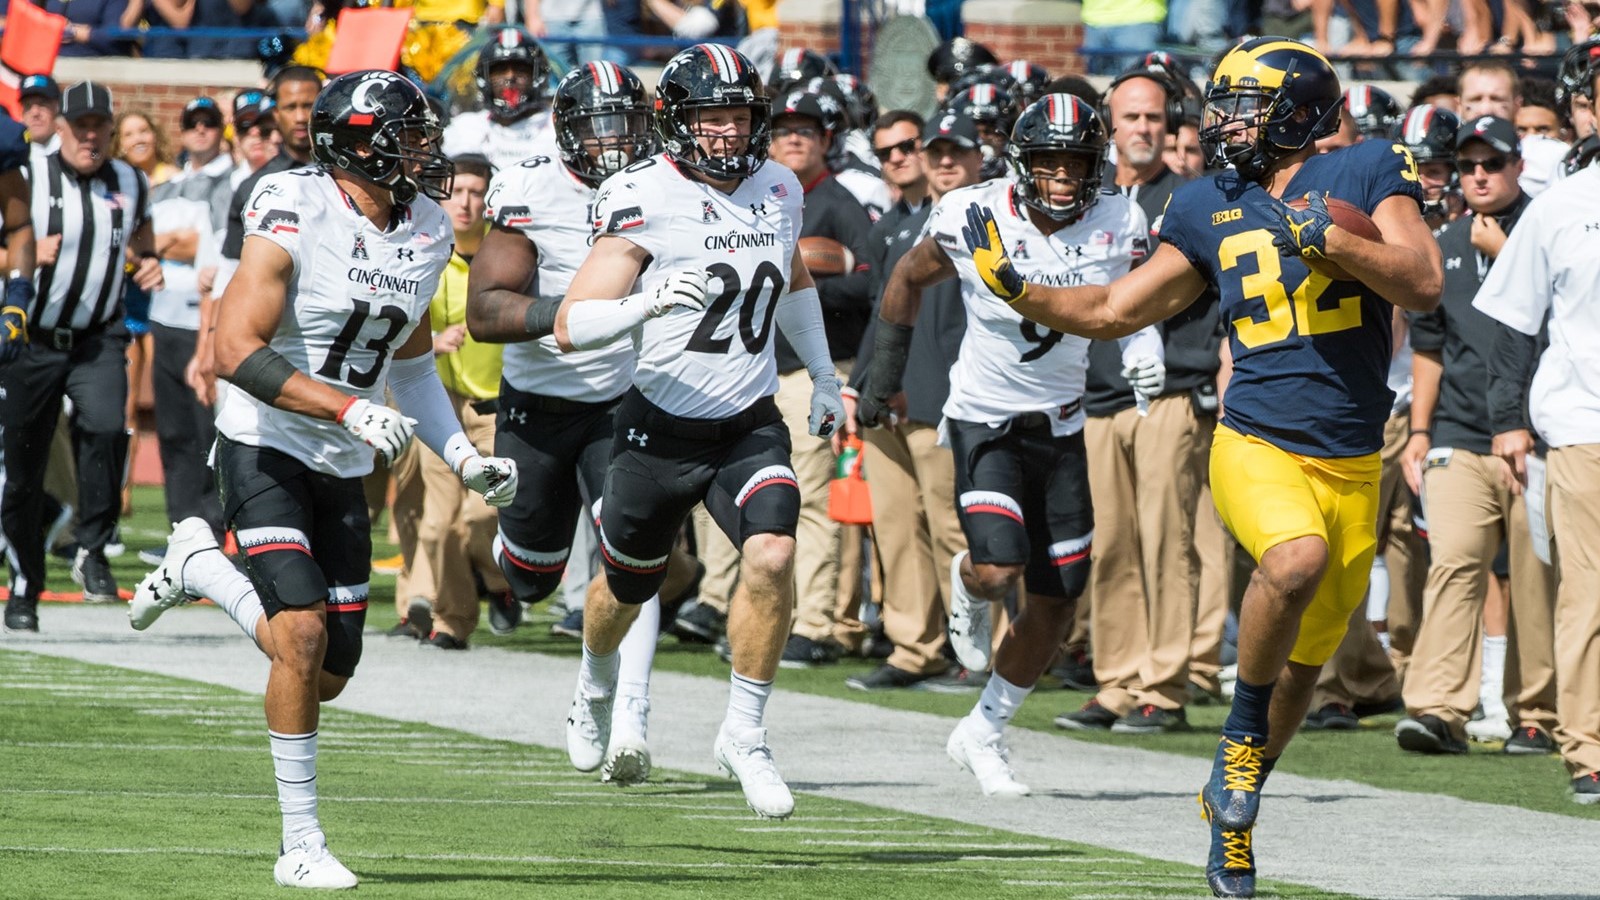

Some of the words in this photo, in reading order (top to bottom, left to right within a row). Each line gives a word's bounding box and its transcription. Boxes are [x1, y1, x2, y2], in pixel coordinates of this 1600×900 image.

[1391, 143, 1422, 183] 3
[704, 231, 775, 251] CINCINNATI
[348, 267, 420, 296] CINCINNATI
[684, 260, 785, 355] 20
[1218, 228, 1363, 349] 32
[315, 298, 409, 388] 13
